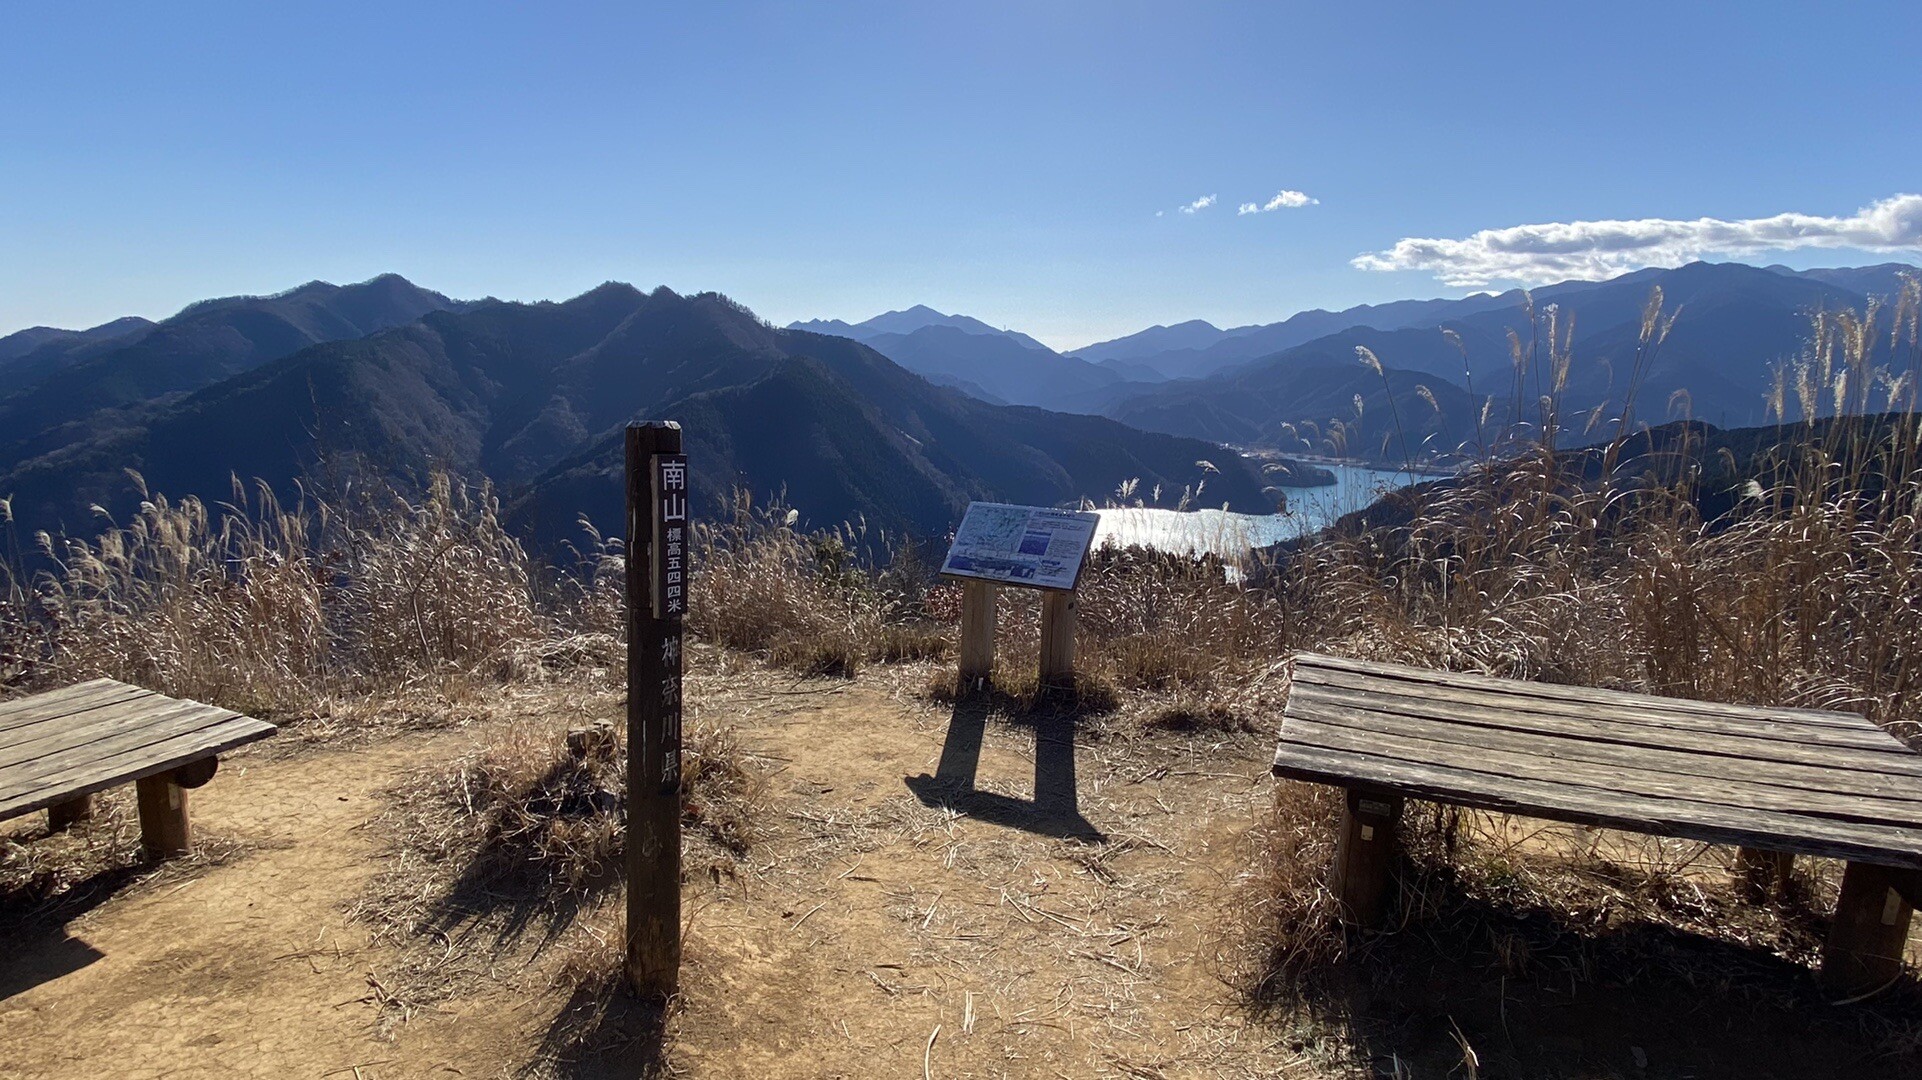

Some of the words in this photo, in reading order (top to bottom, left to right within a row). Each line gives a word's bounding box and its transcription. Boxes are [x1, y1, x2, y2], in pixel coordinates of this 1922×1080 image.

[661, 460, 686, 522] 南山
[667, 527, 682, 613] 標高五四四米
[661, 635, 679, 783] 神奈川県
